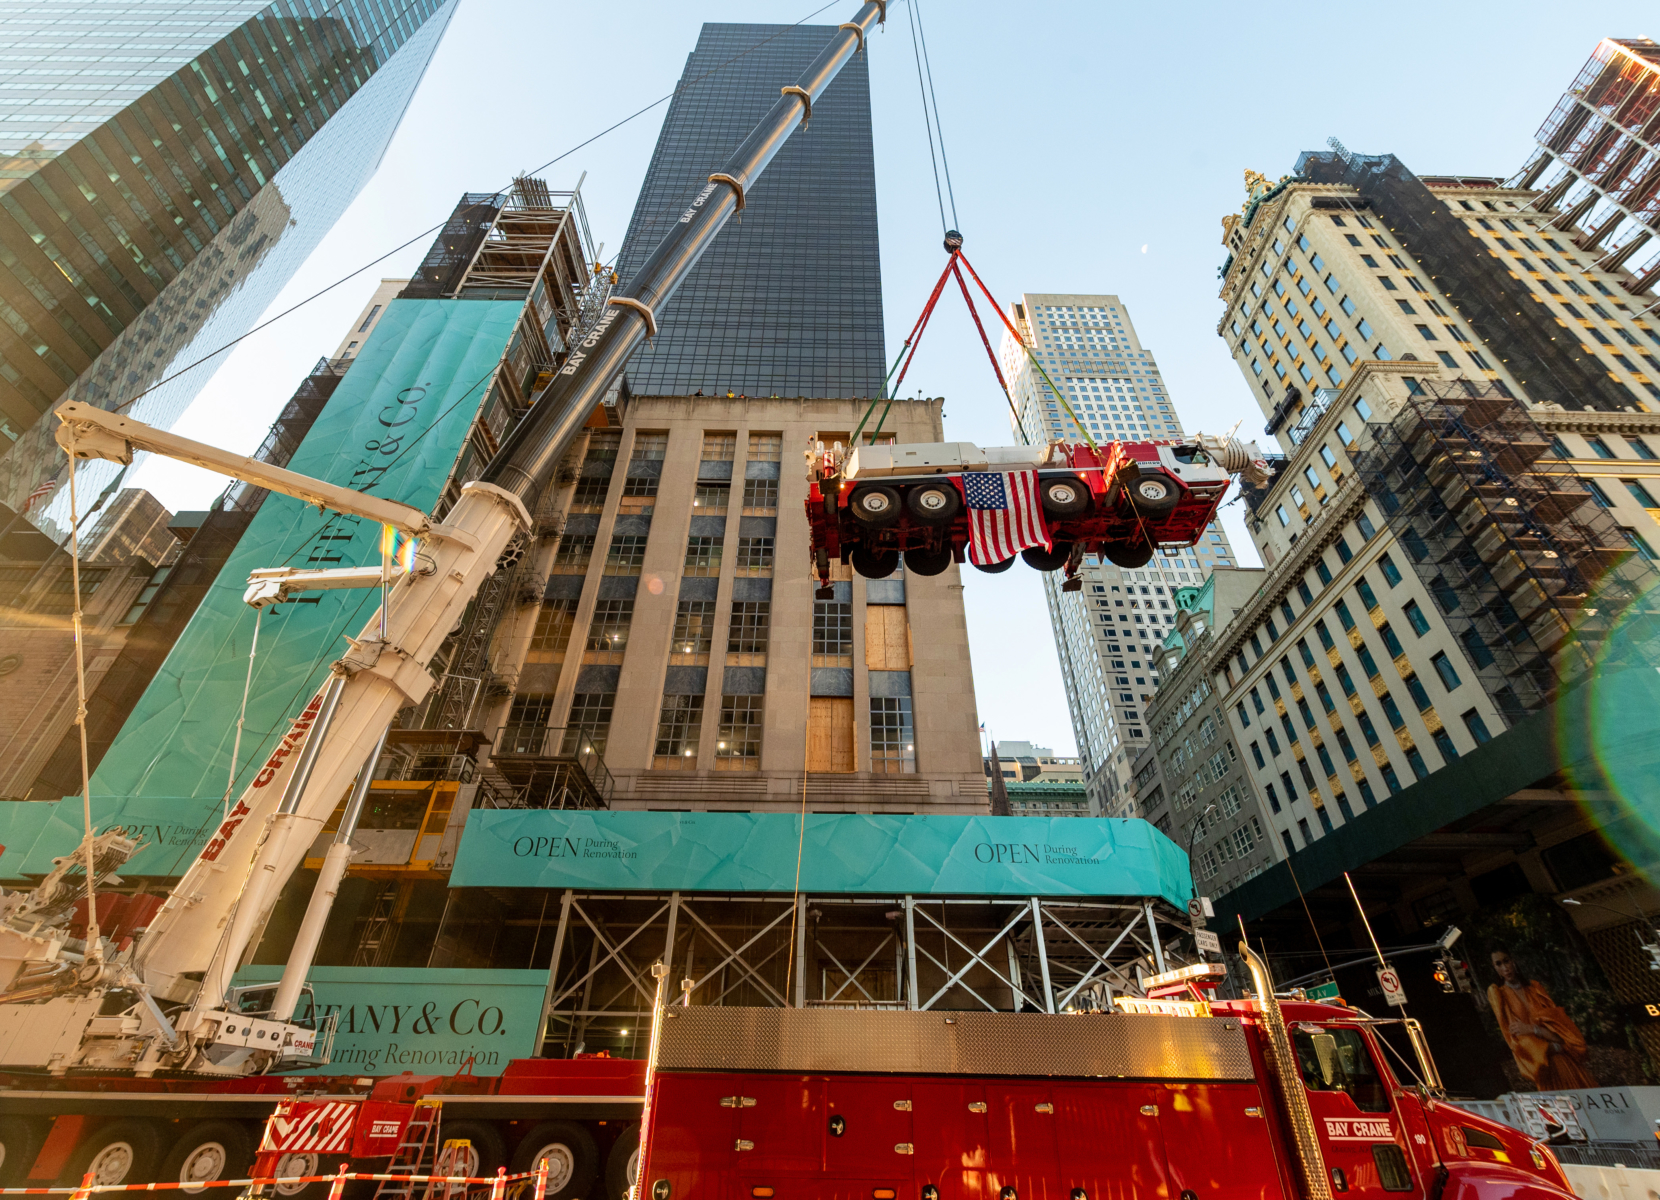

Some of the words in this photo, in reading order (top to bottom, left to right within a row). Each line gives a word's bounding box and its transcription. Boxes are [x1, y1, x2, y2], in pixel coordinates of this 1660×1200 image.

[680, 209, 697, 224] BAY
[693, 182, 719, 208] CRANE
[560, 350, 588, 376] BAY
[584, 308, 621, 349] CRANE
[365, 434, 405, 456] &
[199, 799, 251, 862] BAY
[252, 693, 325, 789] CRANE
[173, 826, 209, 839] During
[513, 836, 582, 858] OPEN
[584, 837, 620, 851] During
[582, 848, 638, 859] Renovation
[974, 842, 1041, 864] OPEN
[1044, 843, 1078, 857] During
[1045, 854, 1101, 865] Renovation
[1196, 931, 1217, 942] PASSENGER
[1197, 939, 1208, 947] CARS
[1209, 941, 1218, 949] ONLY
[1309, 991, 1316, 1001] 5
[412, 1001, 443, 1035] &
[294, 1040, 315, 1050] CRANE
[383, 1042, 499, 1066] Renovation
[372, 1124, 383, 1134] BAY
[382, 1124, 399, 1134] CRANE
[1325, 1122, 1349, 1136] BAY
[1352, 1122, 1393, 1137] CRANE
[1414, 1133, 1427, 1145] 190
